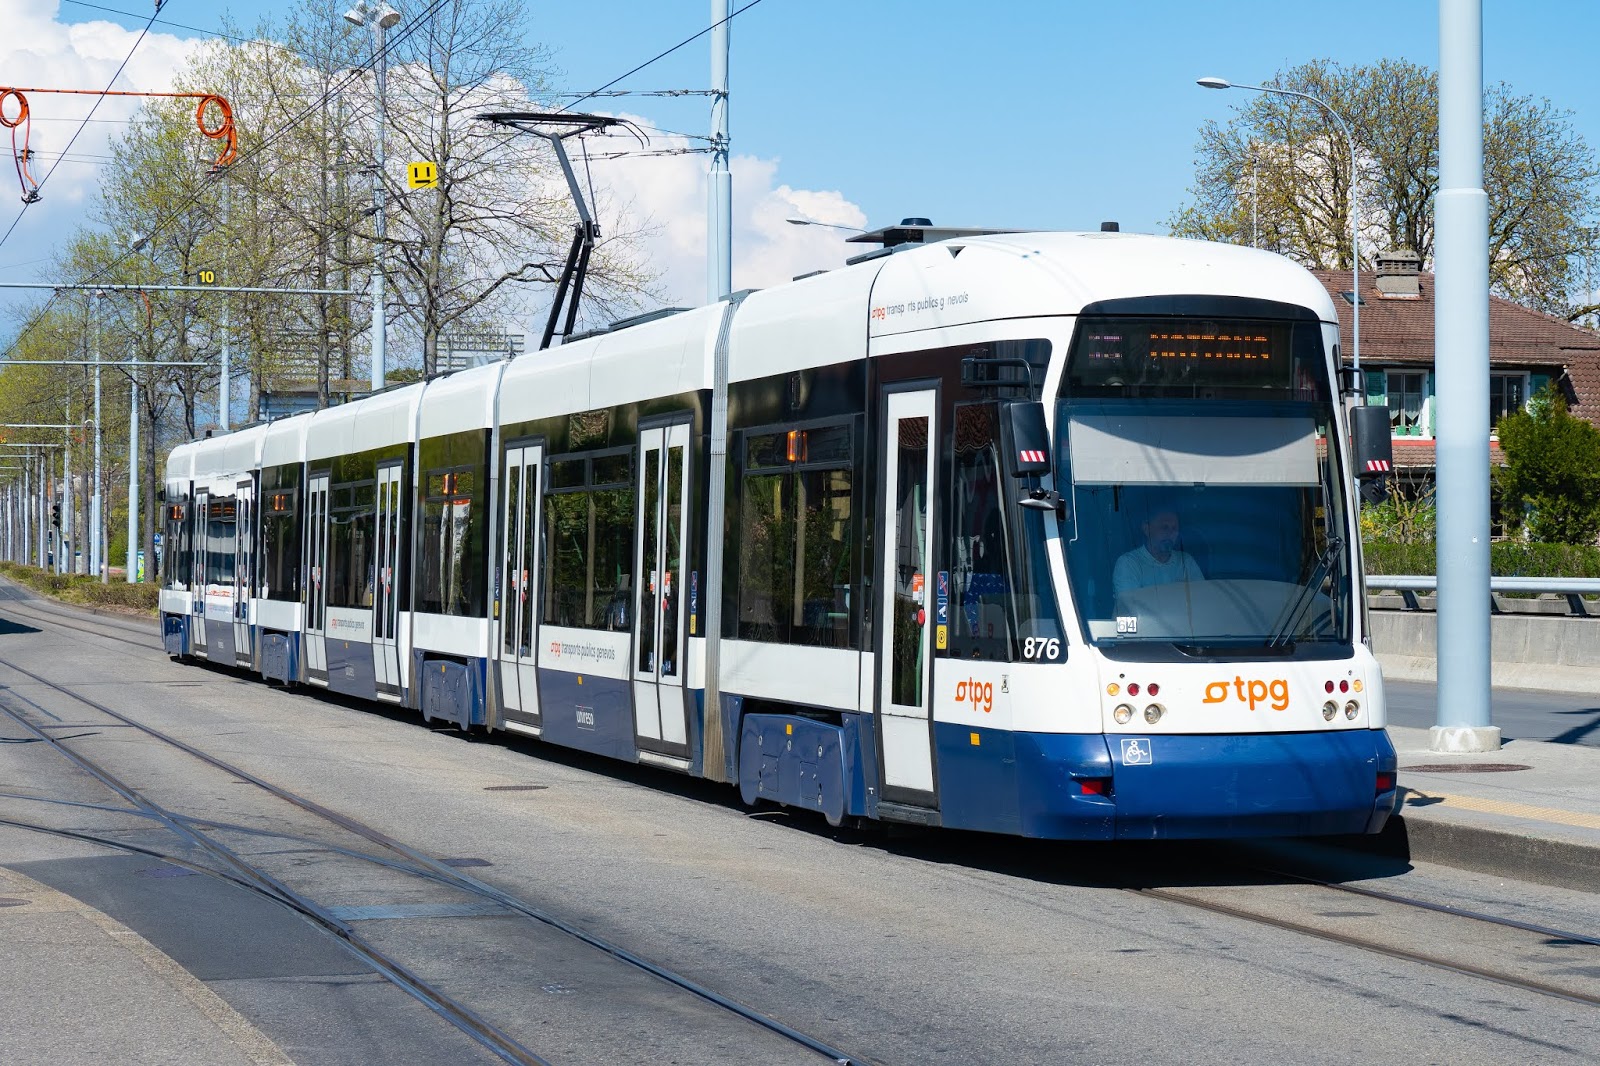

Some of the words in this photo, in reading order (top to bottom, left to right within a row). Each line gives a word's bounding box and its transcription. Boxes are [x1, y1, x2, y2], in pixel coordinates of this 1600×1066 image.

[198, 270, 214, 283] 10
[917, 296, 938, 314] publics
[1118, 619, 1136, 631] 64
[1023, 636, 1060, 660] 876
